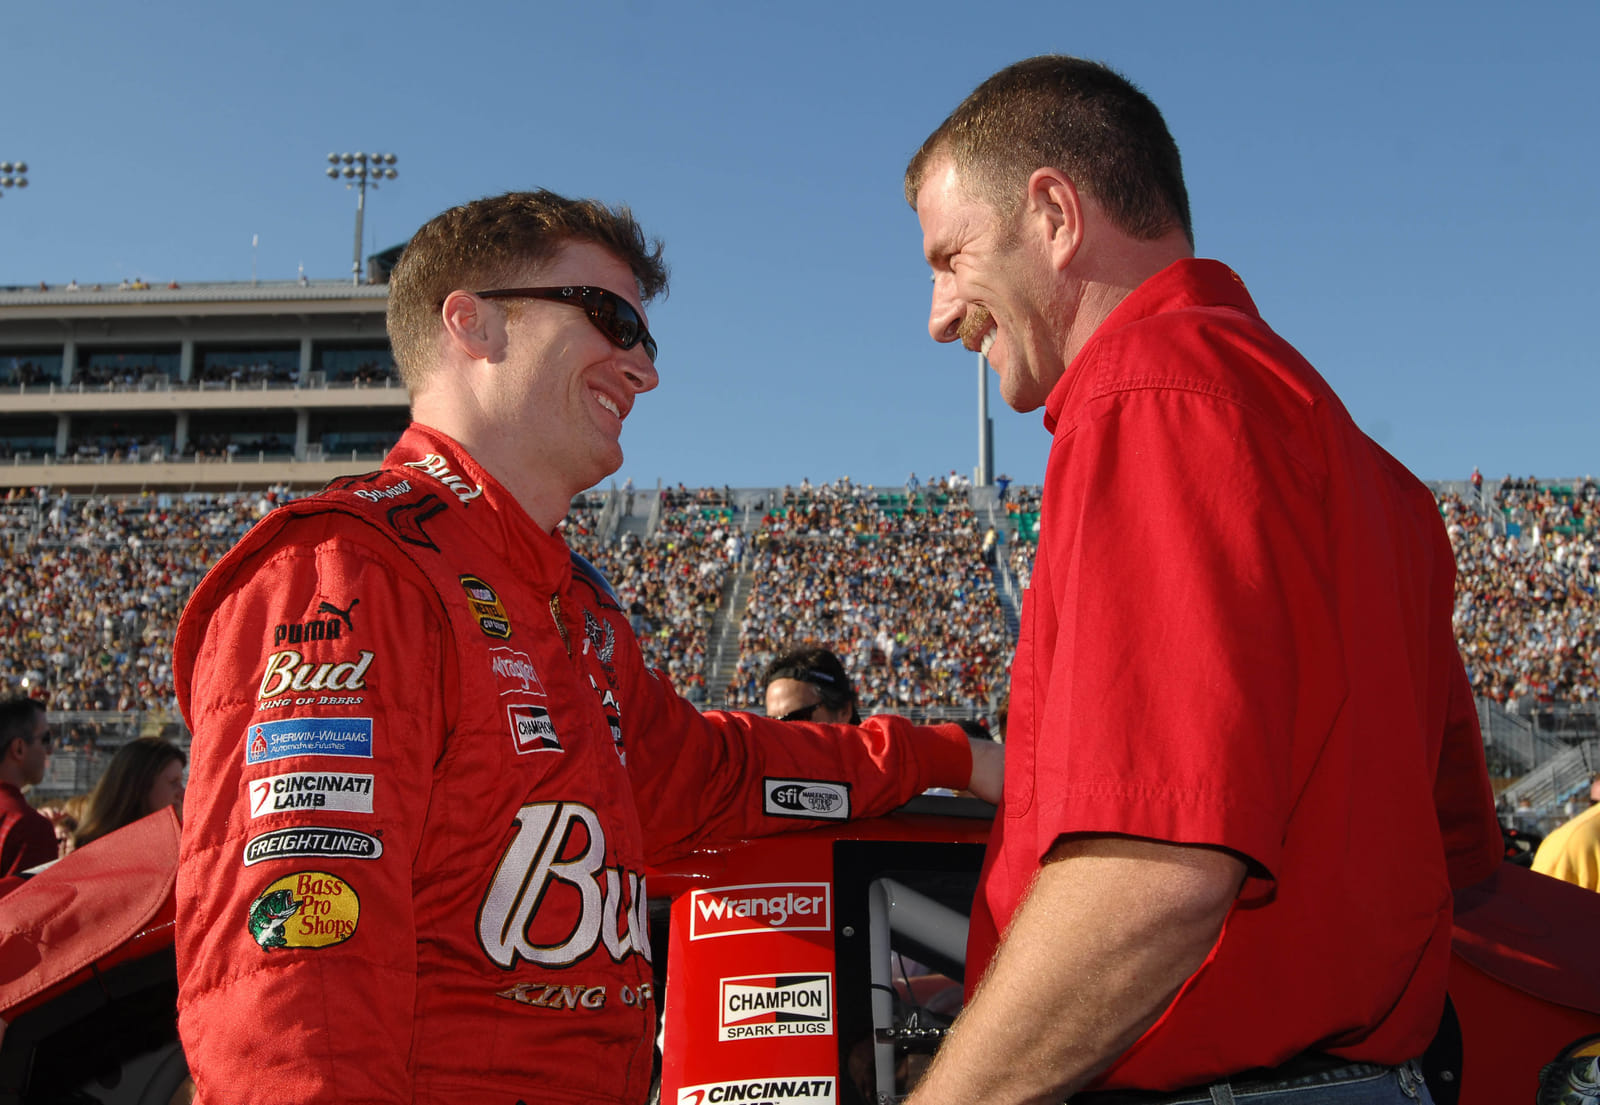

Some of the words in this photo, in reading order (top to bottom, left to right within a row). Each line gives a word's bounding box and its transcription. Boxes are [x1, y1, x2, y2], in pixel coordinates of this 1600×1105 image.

[403, 453, 482, 503] Bud
[275, 619, 341, 647] PUMA
[258, 649, 375, 701] Bud
[258, 698, 292, 711] KING
[296, 697, 315, 705] OF
[317, 696, 363, 705] BEERS
[270, 730, 367, 746] SHERWIN-WILLIAMS
[273, 776, 372, 794] CINCINNATI
[777, 788, 797, 804] sfi
[273, 793, 326, 810] LAMB
[250, 834, 369, 859] FREIGHTLINER
[296, 874, 343, 896] Bass
[298, 895, 331, 916] Pro
[697, 893, 824, 926] Wrangler
[299, 915, 354, 939] Shops
[496, 983, 607, 1010] KING
[729, 990, 822, 1011] CHAMPION
[727, 1024, 774, 1038] SPARK
[778, 1022, 826, 1034] PLUGS
[708, 1081, 832, 1103] CINCINNATI
